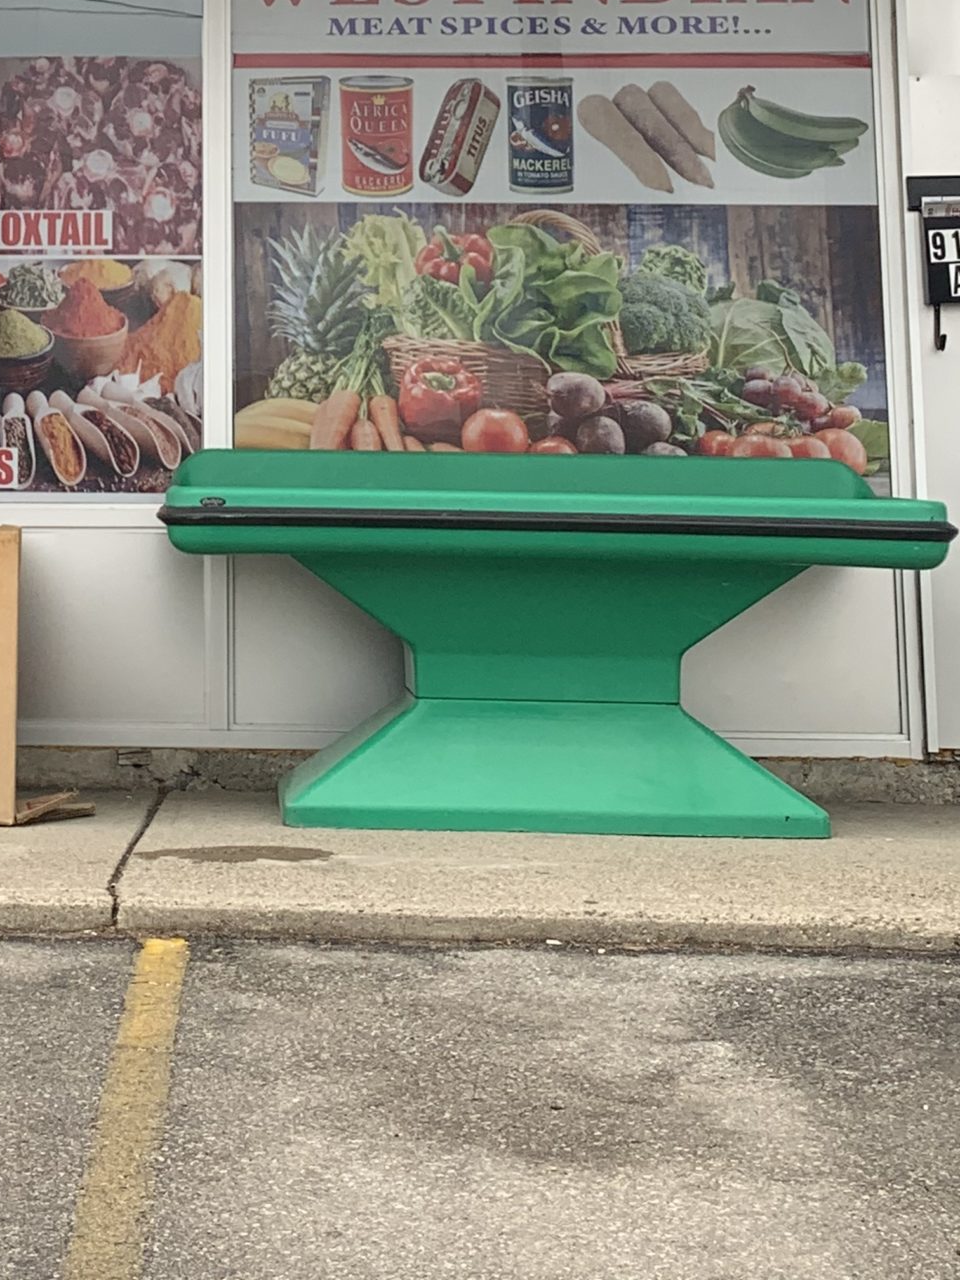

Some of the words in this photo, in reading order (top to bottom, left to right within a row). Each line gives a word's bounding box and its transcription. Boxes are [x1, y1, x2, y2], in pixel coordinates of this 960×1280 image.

[326, 17, 432, 36] MEAT
[440, 16, 572, 35] SPICES
[580, 17, 608, 35] &
[513, 88, 570, 108] GEISHA
[467, 116, 487, 158] TITUS
[513, 158, 571, 171] MACKEREL
[0, 213, 109, 247] OXTAIL
